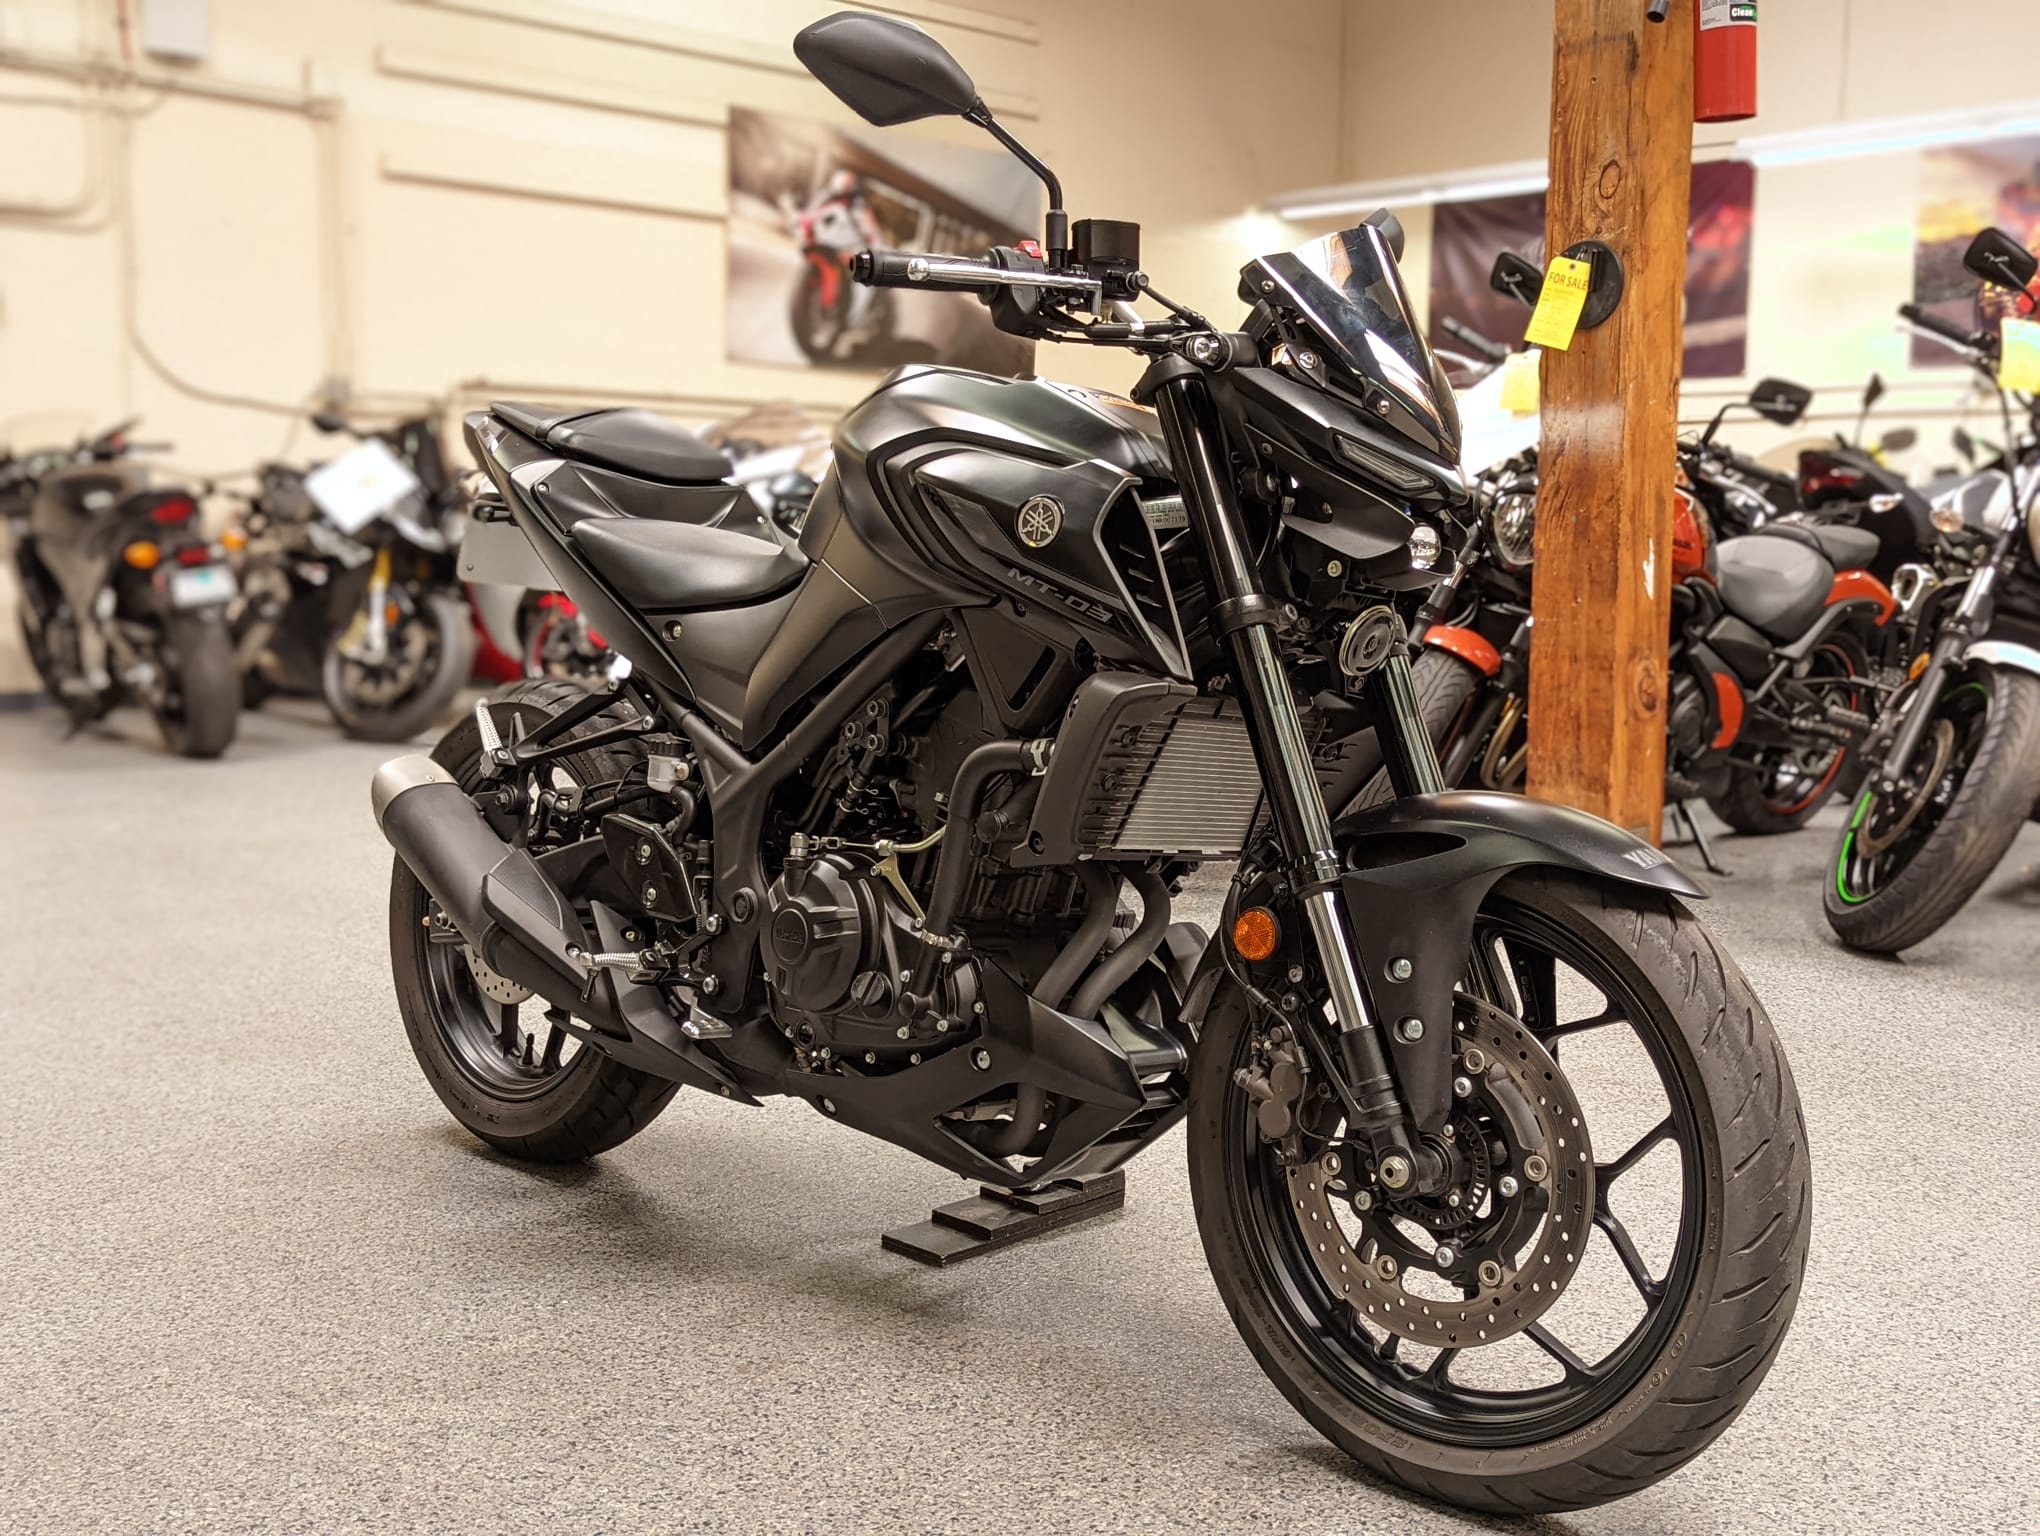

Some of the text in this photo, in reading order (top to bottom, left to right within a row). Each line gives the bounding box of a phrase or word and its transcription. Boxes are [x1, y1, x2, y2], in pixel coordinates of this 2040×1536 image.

[1548, 272, 1588, 292] FOR SALE
[1007, 567, 1114, 623] MT-03
